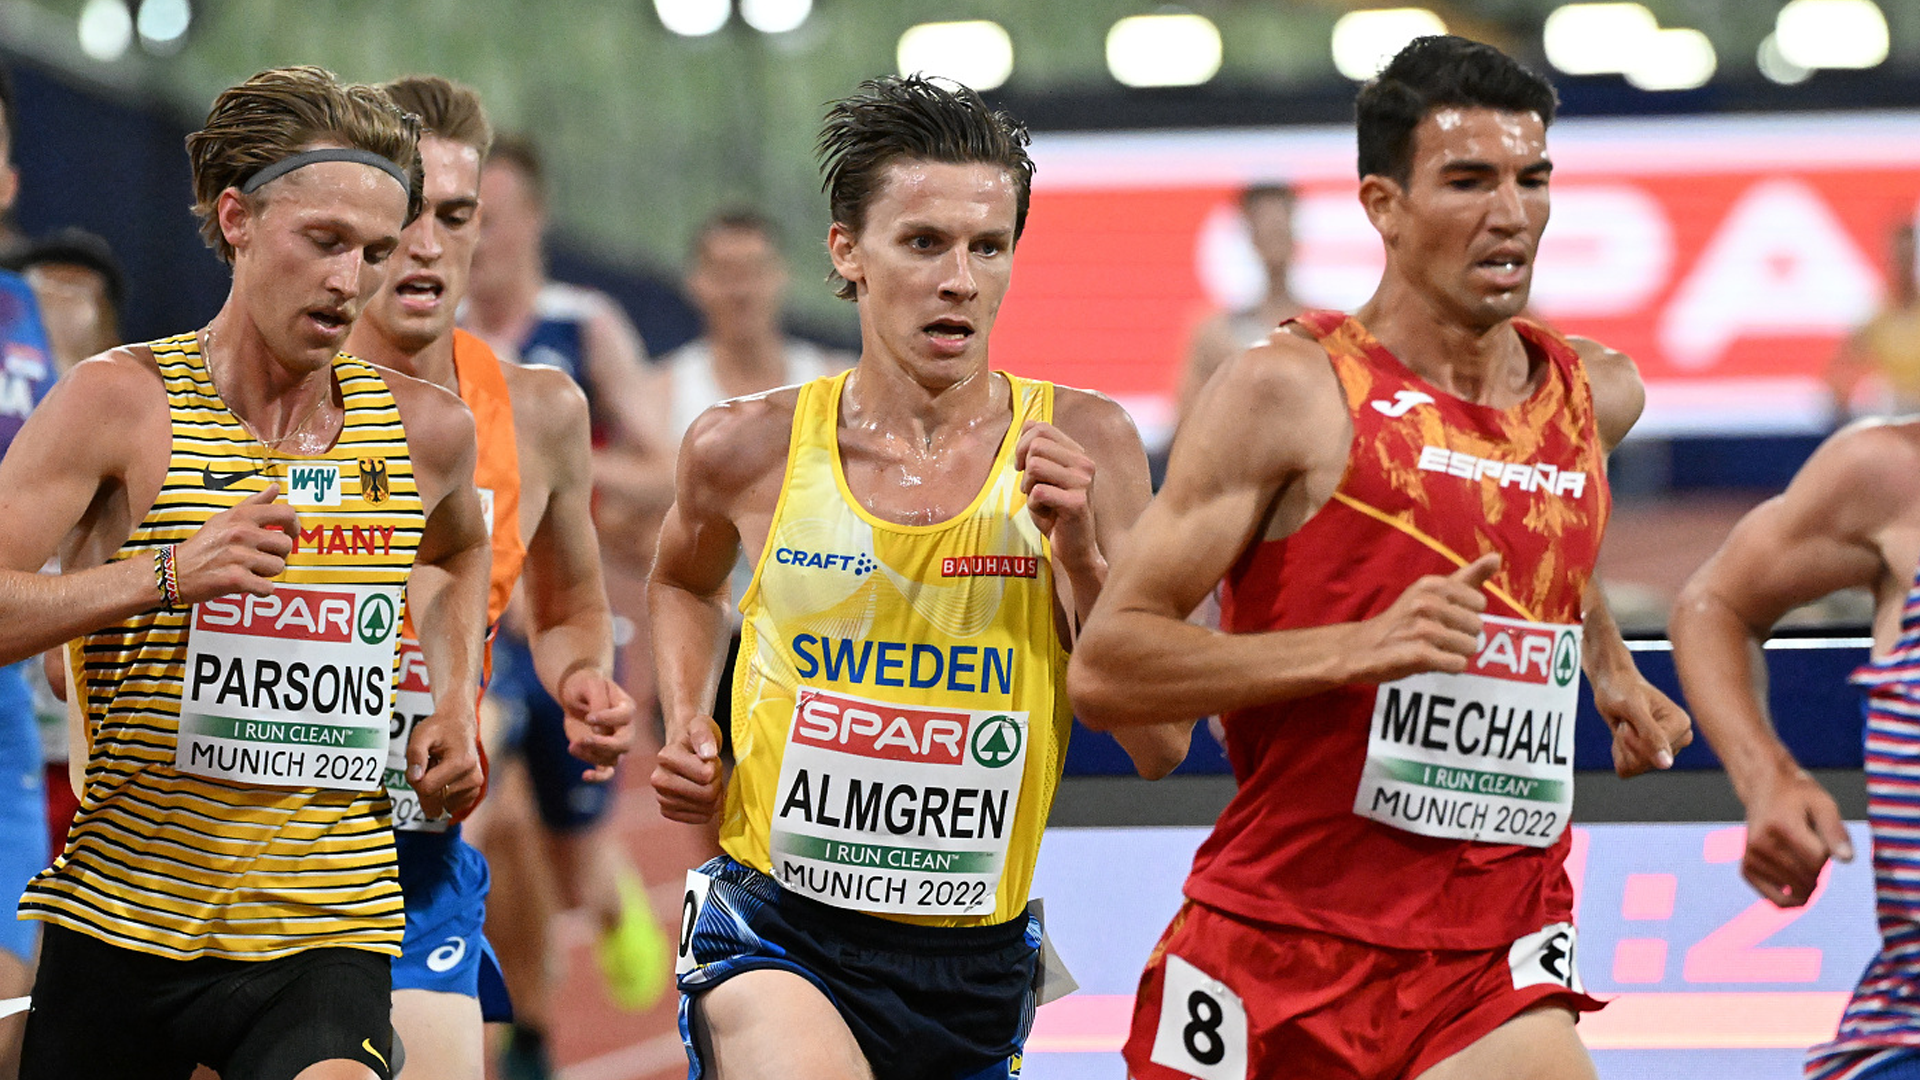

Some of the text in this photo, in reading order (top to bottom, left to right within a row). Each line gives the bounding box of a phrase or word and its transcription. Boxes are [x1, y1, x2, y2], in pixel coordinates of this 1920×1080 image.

[1417, 445, 1586, 498] ESPAÑA
[776, 548, 855, 572] CRAFT
[943, 557, 1036, 574] BAUHAUS
[202, 592, 351, 636] SPAR
[191, 653, 385, 716] PARSONS
[792, 633, 1013, 694] SWEDEN
[233, 721, 240, 737] I
[245, 722, 284, 741] RUN
[799, 701, 963, 757] SPAR
[1380, 687, 1567, 766] MECHAAL
[190, 741, 305, 777] MUNICH
[313, 753, 377, 782] 2022
[1423, 766, 1430, 784] I
[1435, 767, 1476, 791] RUN
[779, 768, 1009, 839] ALMGREN
[1371, 786, 1557, 838] MUNICH 2022
[825, 842, 831, 859] I
[837, 846, 881, 864] RUN
[783, 860, 986, 906] MUNICH 2022
[1183, 989, 1226, 1066] 8
